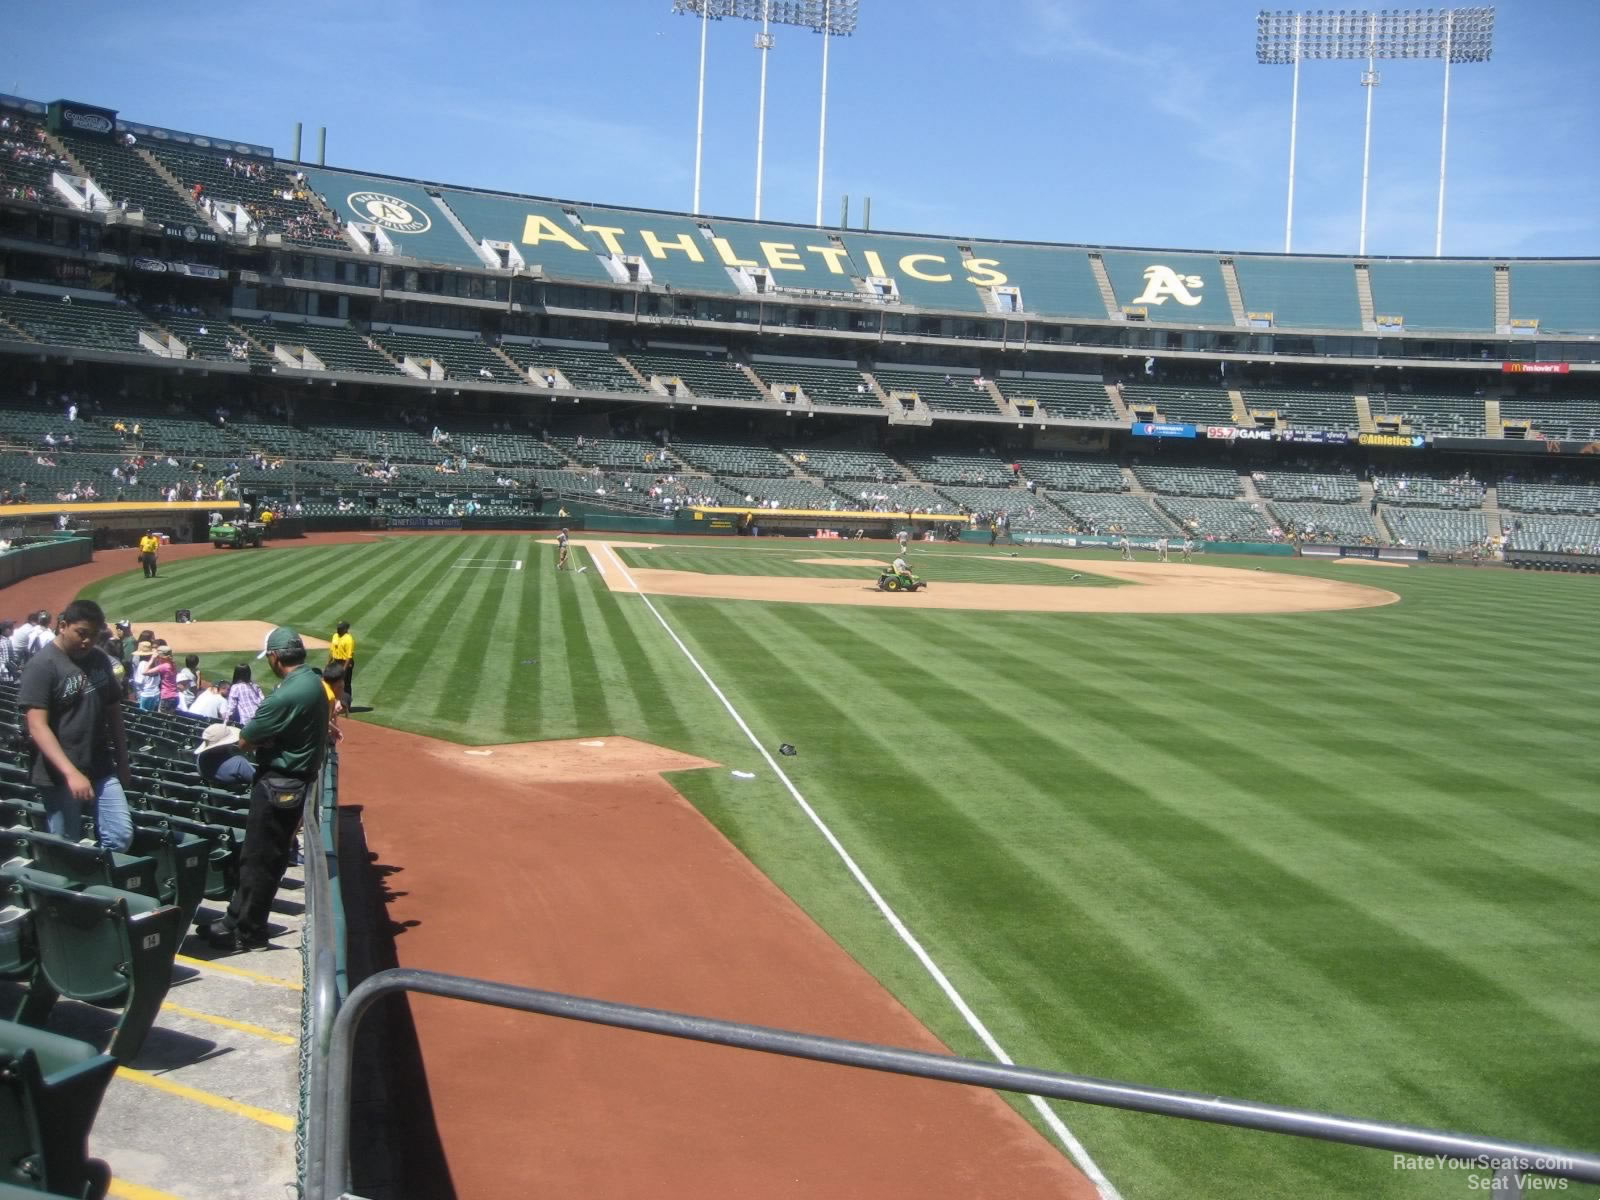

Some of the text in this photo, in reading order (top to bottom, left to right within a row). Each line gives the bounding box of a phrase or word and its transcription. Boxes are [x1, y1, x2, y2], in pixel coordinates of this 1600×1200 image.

[167, 228, 216, 241] BILL KING
[523, 214, 1008, 286] ATHLETICS
[1208, 427, 1234, 438] 95.7
[1239, 429, 1271, 440] GAME
[1326, 431, 1347, 440] xfinity
[1359, 433, 1412, 447] @Athletics
